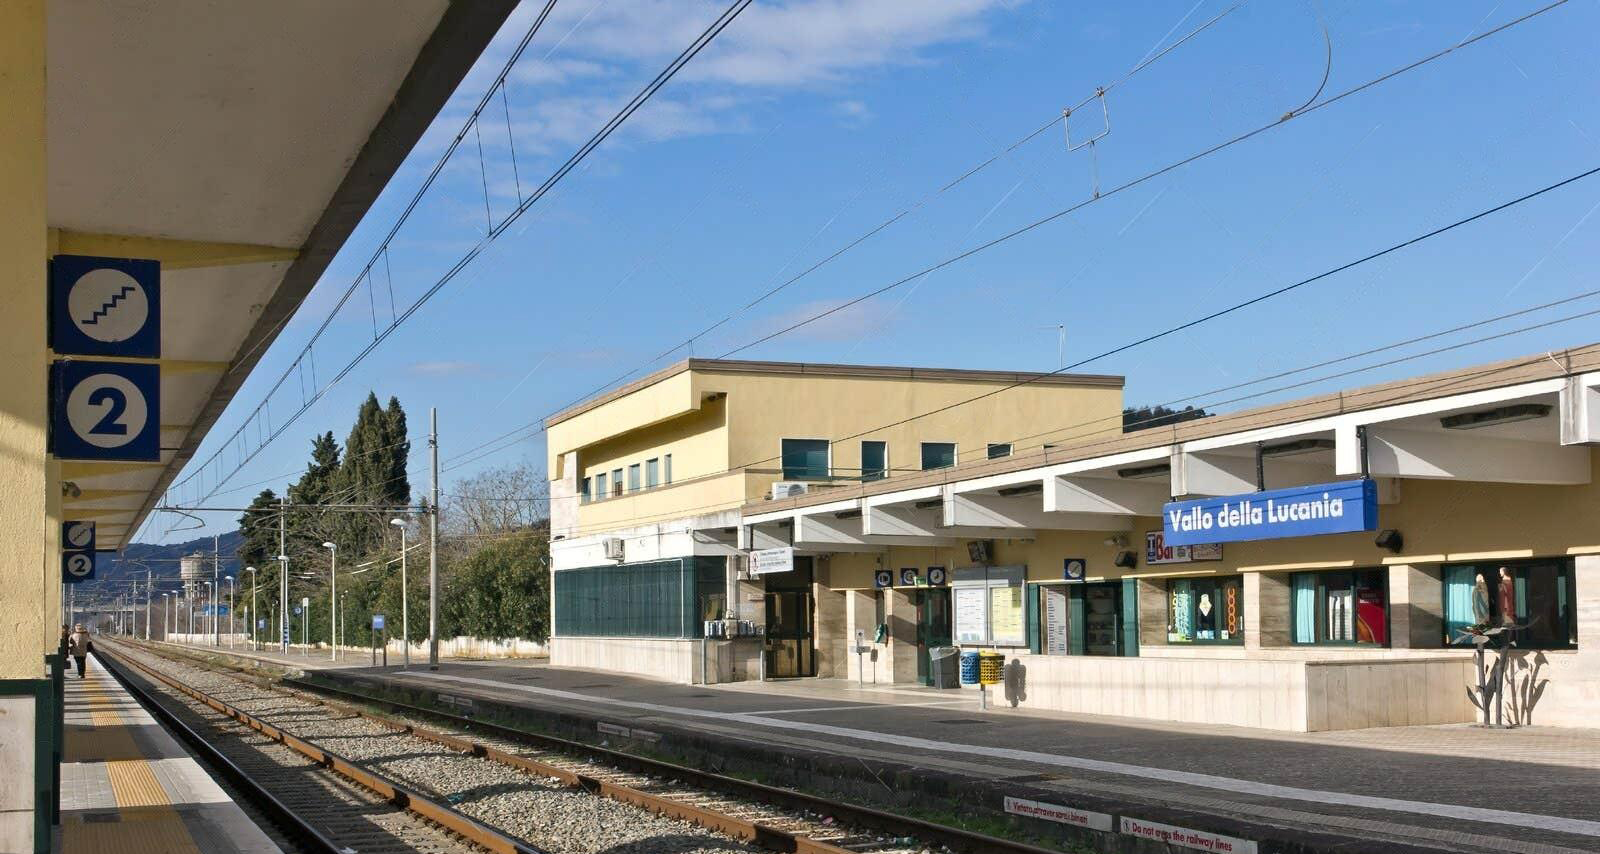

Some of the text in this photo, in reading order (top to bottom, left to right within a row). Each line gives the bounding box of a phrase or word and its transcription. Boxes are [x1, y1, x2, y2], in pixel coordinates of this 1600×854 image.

[88, 386, 128, 436] 2
[1169, 492, 1344, 532] Vallo della Lucania
[74, 558, 86, 573] 2
[1132, 822, 1141, 833] Do
[1143, 825, 1154, 836] not
[1173, 829, 1184, 842] the
[1186, 833, 1214, 850] railway
[1216, 838, 1232, 852] lines
